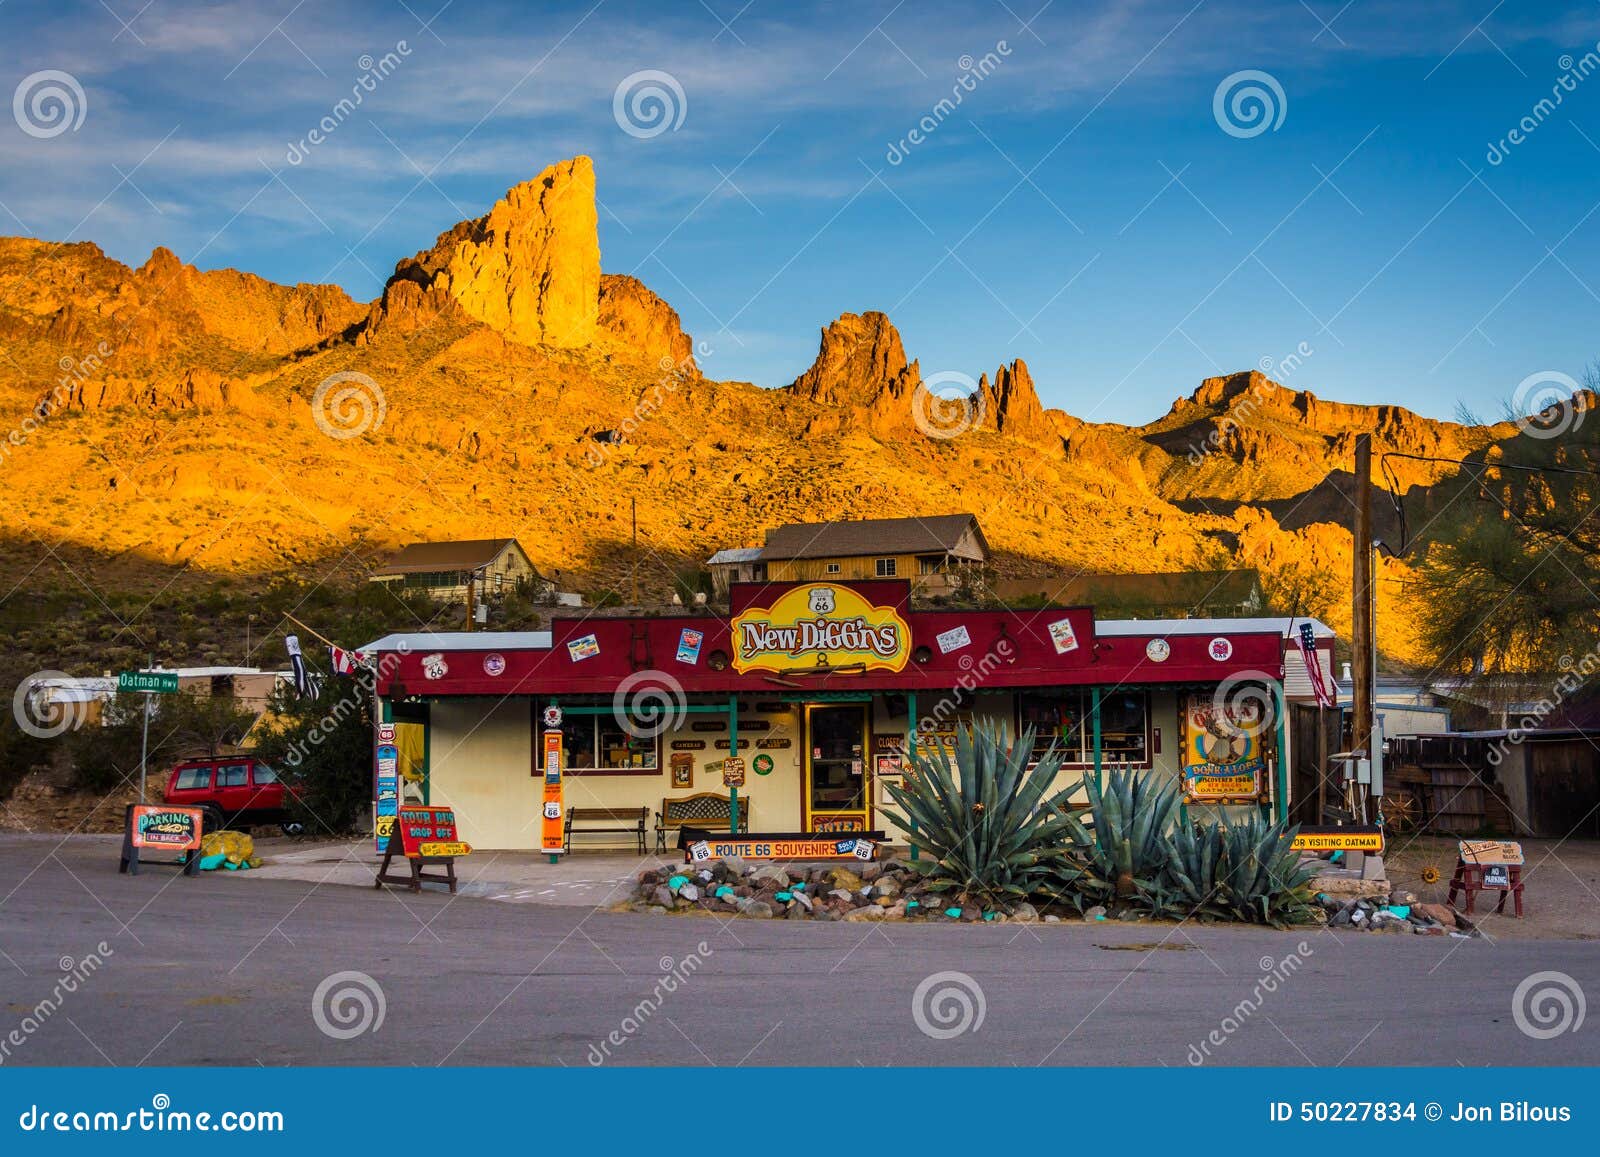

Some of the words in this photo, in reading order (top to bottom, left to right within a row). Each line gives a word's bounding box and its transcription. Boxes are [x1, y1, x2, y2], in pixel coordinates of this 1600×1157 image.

[815, 601, 829, 611] 66
[430, 665, 443, 678] 66
[120, 673, 160, 687] Oatman
[401, 811, 431, 825] TOUR
[138, 813, 190, 834] PARKING
[815, 821, 862, 832] ENTER
[1309, 838, 1341, 846] VISITING
[1345, 838, 1376, 846] OATMAN
[697, 849, 709, 859] 66
[715, 844, 752, 857] ROUTE
[755, 844, 771, 857] 66
[775, 843, 837, 856] SOUVENIRS
[856, 848, 868, 858] 66
[1491, 867, 1500, 876] NO
[1485, 875, 1507, 884] PARKING
